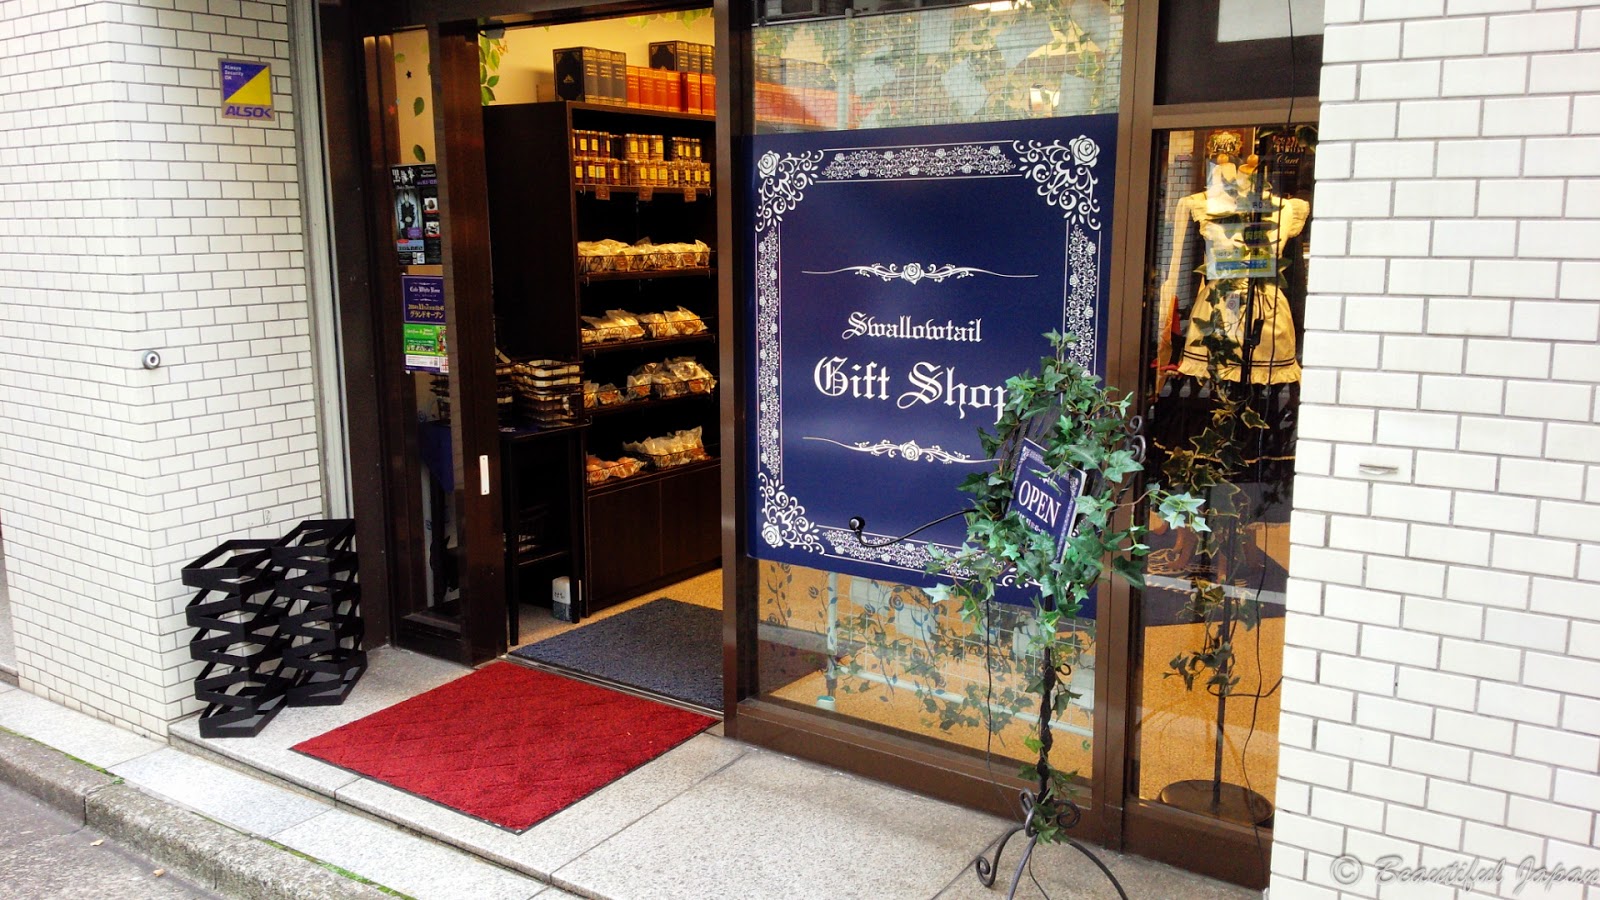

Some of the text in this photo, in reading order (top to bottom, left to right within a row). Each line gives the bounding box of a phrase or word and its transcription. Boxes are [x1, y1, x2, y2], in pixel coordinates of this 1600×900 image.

[225, 105, 272, 118] ALSOK
[841, 311, 982, 342] Swallowtail
[813, 356, 890, 400] Gift
[1018, 480, 1061, 528] OPEN
